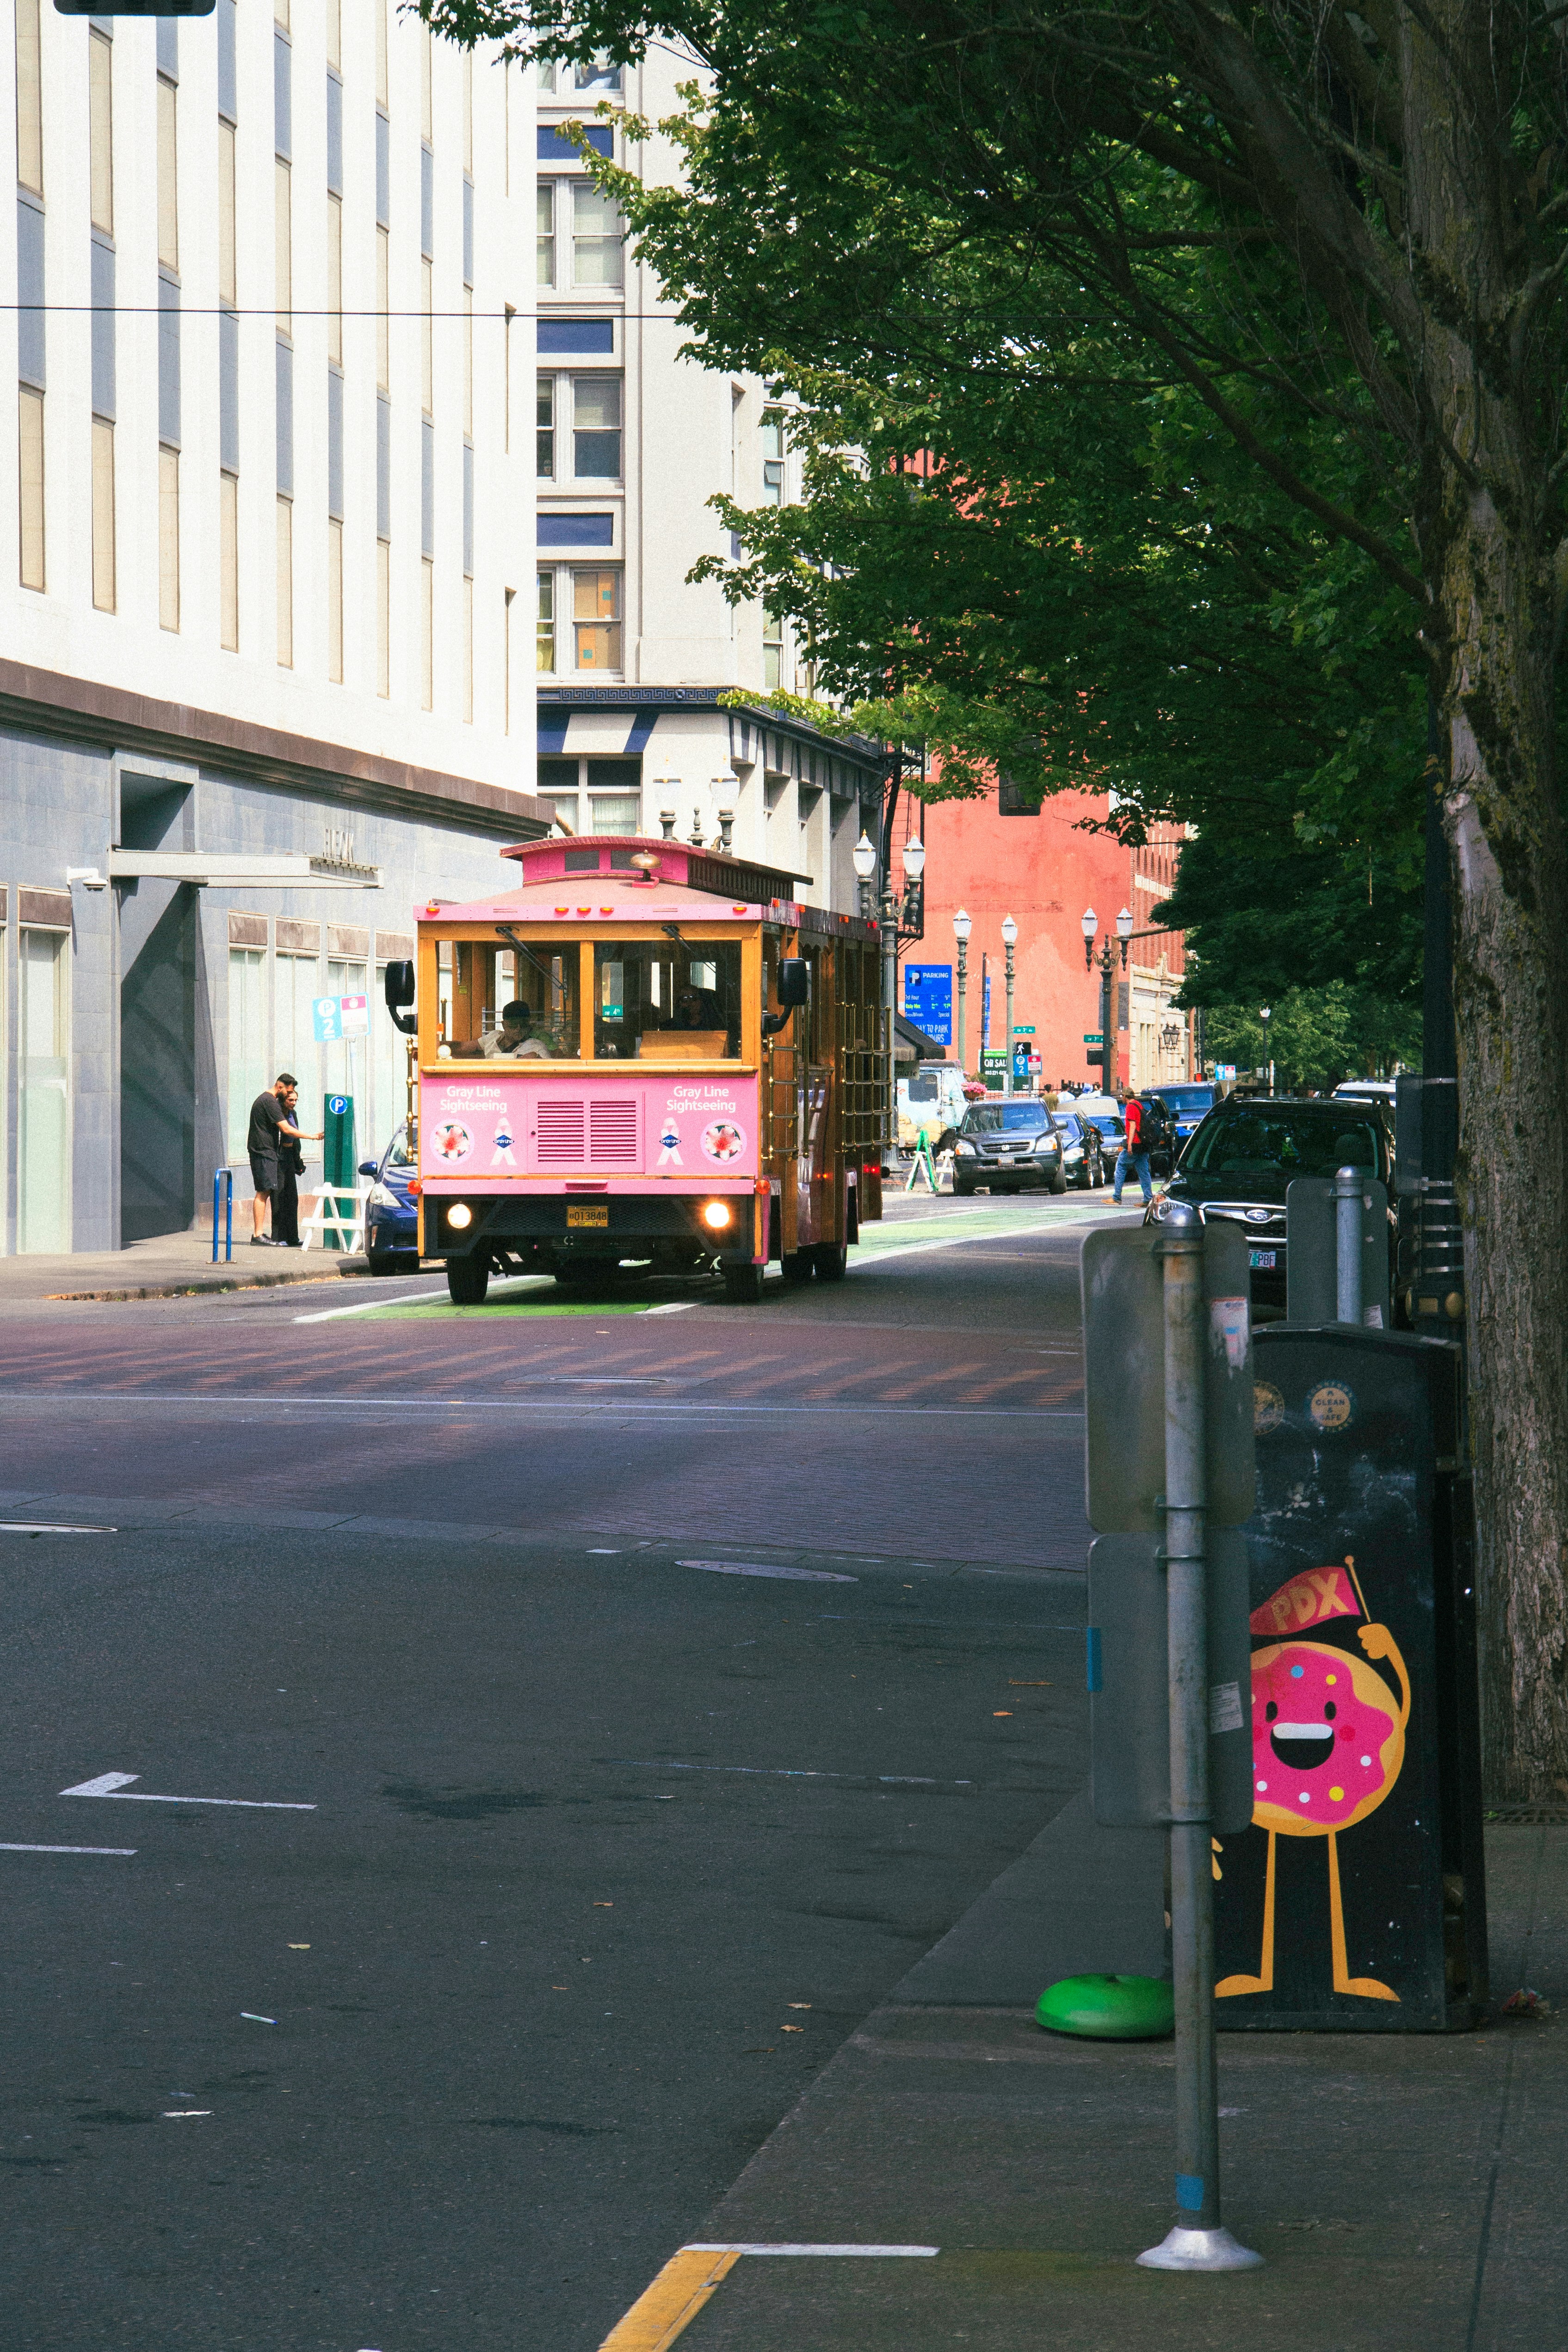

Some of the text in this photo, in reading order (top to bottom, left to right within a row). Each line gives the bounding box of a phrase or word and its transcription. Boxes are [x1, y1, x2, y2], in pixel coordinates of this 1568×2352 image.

[323, 1018, 334, 1034] 2
[926, 1024, 934, 1034] TO
[934, 1024, 949, 1034] PARK
[926, 1034, 945, 1043] OURS
[984, 1059, 1007, 1068] OR SAL
[1019, 1065, 1025, 1074] 2
[446, 1086, 501, 1099] Gray Line
[673, 1086, 729, 1099] Gray Line
[439, 1099, 507, 1113] Sightseeing
[667, 1099, 736, 1113] Sightseeing
[1272, 1573, 1350, 1631] PDX
